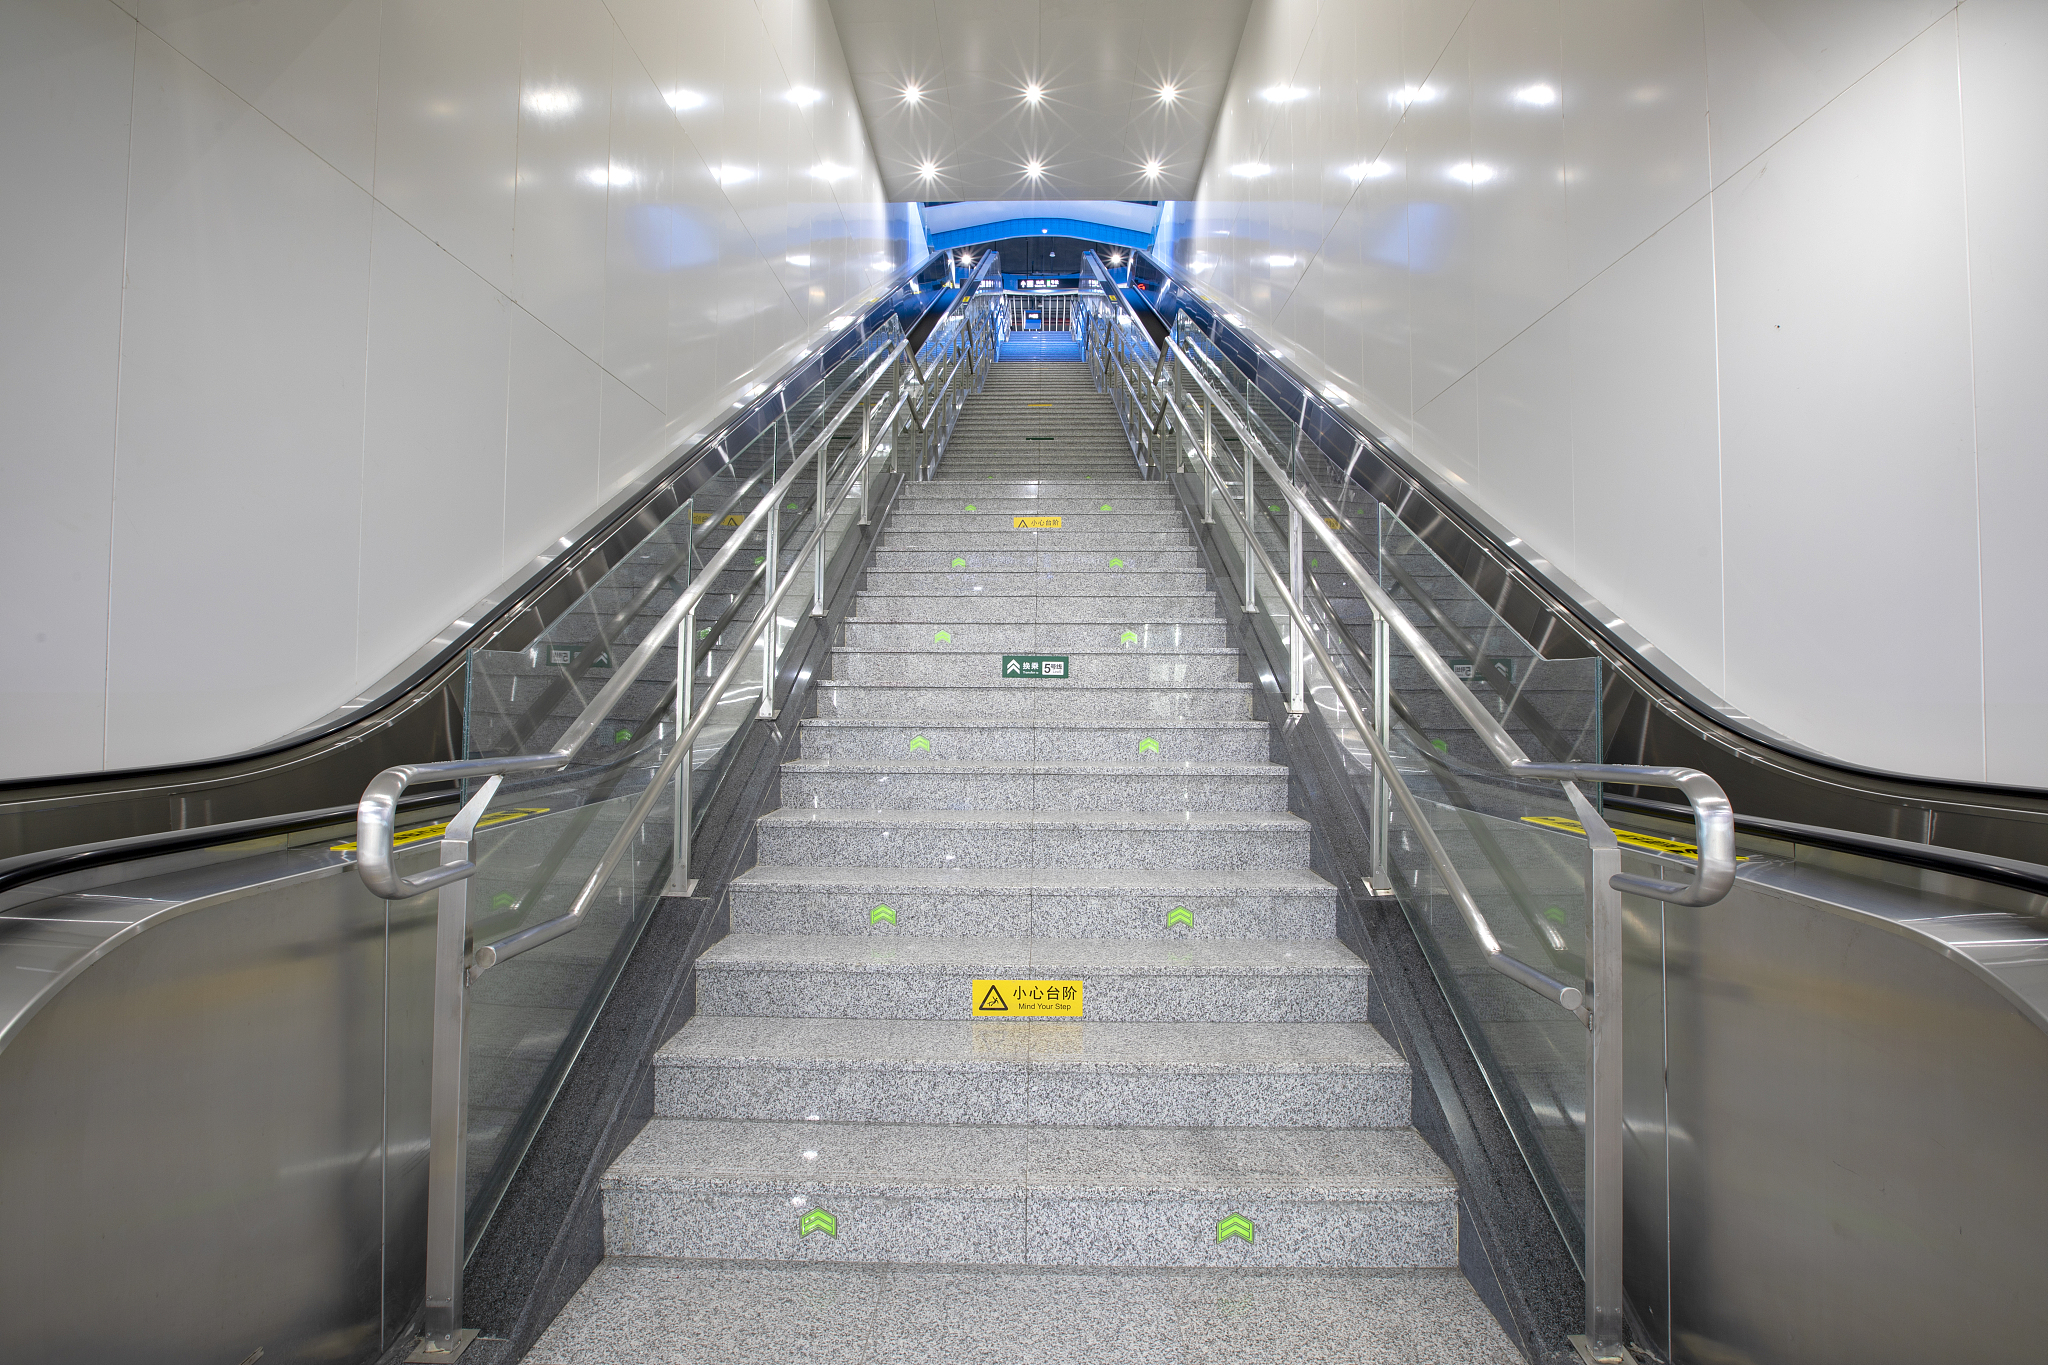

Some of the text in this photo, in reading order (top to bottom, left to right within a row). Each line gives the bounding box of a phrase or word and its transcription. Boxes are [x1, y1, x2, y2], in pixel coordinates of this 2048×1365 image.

[1013, 985, 1077, 1000] 小心台阶
[1055, 1003, 1071, 1011] Step
